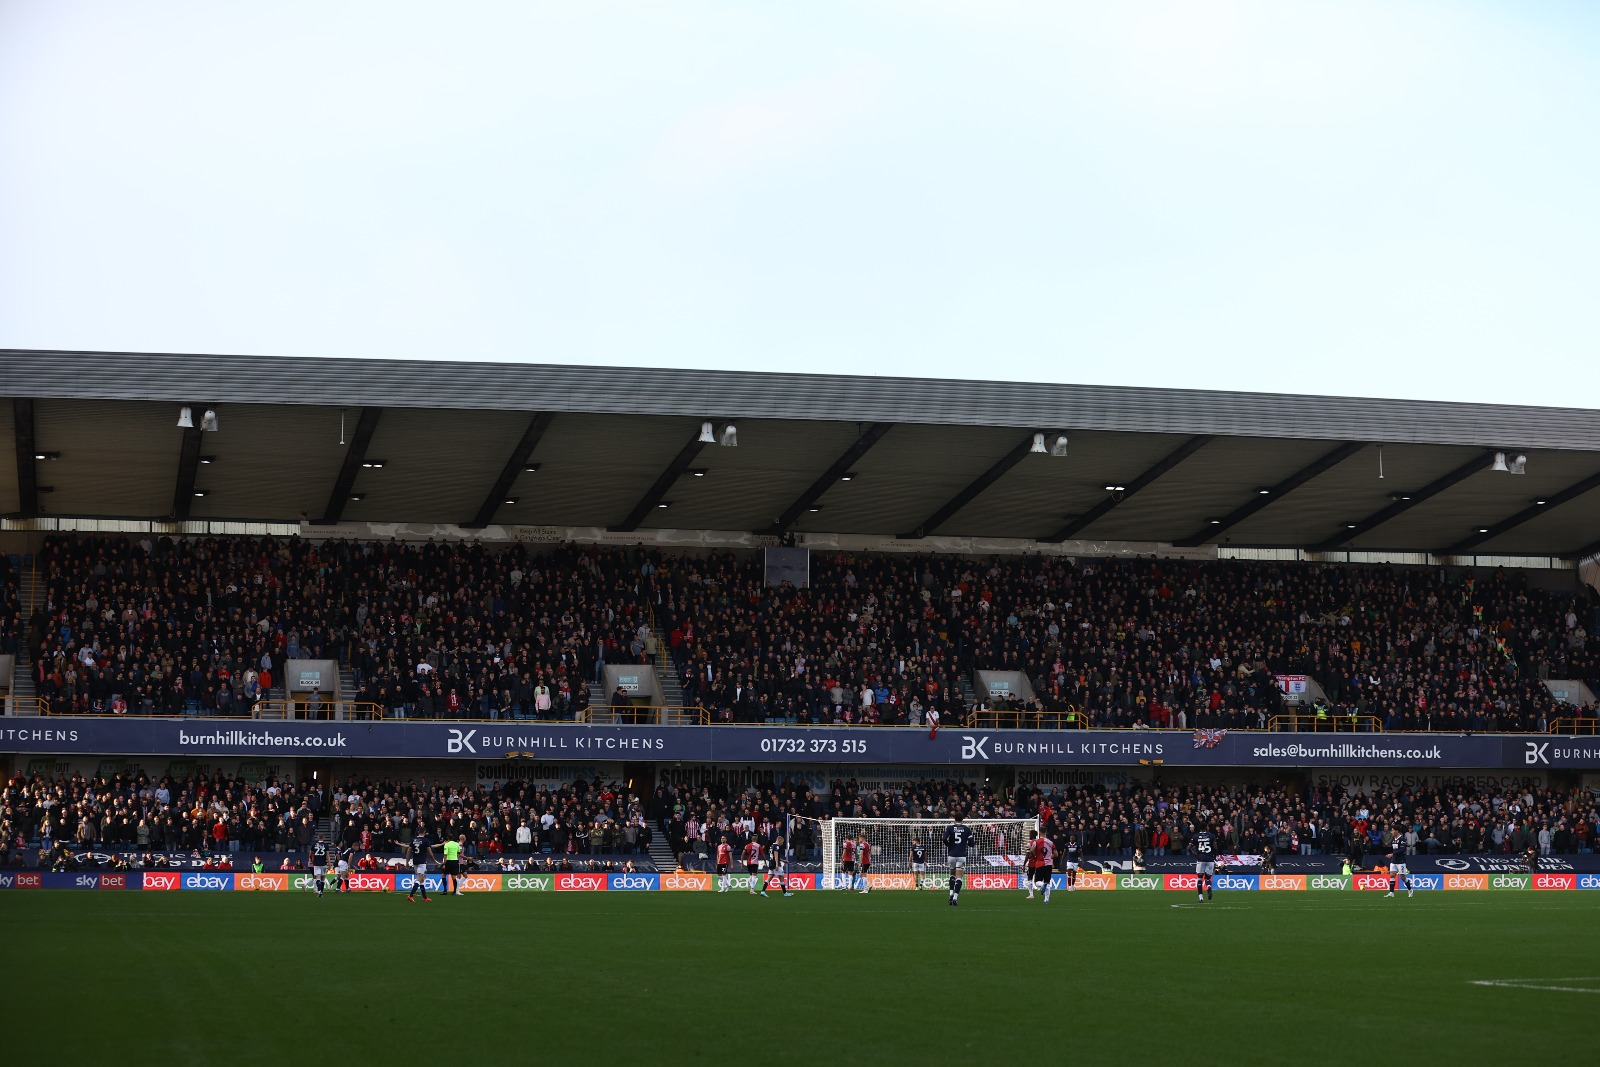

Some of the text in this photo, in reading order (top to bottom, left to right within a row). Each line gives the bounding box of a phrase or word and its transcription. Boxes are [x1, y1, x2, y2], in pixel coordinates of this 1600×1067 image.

[179, 730, 347, 747] burnhillkitchens.co.uk
[447, 729, 664, 753] BK BURNHILL KITCHENS
[760, 738, 867, 753] 01732 373 515
[962, 736, 1163, 759] BK BURNHILL KITCHENS
[1253, 743, 1442, 760] sales@burnhillkitchens.co.uk
[1525, 742, 1550, 764] BK
[1319, 774, 1364, 787] SHOW
[1370, 775, 1428, 788] RACISM
[954, 832, 962, 844] 5
[314, 846, 325, 856] 23
[414, 843, 420, 854] 3
[916, 850, 923, 859] 9
[1198, 842, 1212, 854] 45
[17, 874, 39, 886] bet
[75, 874, 123, 888] sky bet
[186, 873, 229, 890] ebay
[240, 874, 283, 890] ebay
[348, 874, 390, 890] ebay
[507, 874, 549, 890] ebay
[560, 874, 602, 890] ebay
[613, 874, 654, 890] ebay
[665, 874, 707, 890] ebay
[872, 874, 911, 890] ebay
[972, 874, 1013, 890] ebay
[1074, 874, 1114, 890] ebay
[1120, 874, 1159, 890] ebay
[1217, 874, 1254, 890] ebay
[1264, 875, 1301, 890] ebay
[1311, 875, 1348, 890] ebay
[1448, 875, 1484, 890] ebay
[1492, 875, 1528, 890] ebay
[1537, 874, 1572, 890] ebay
